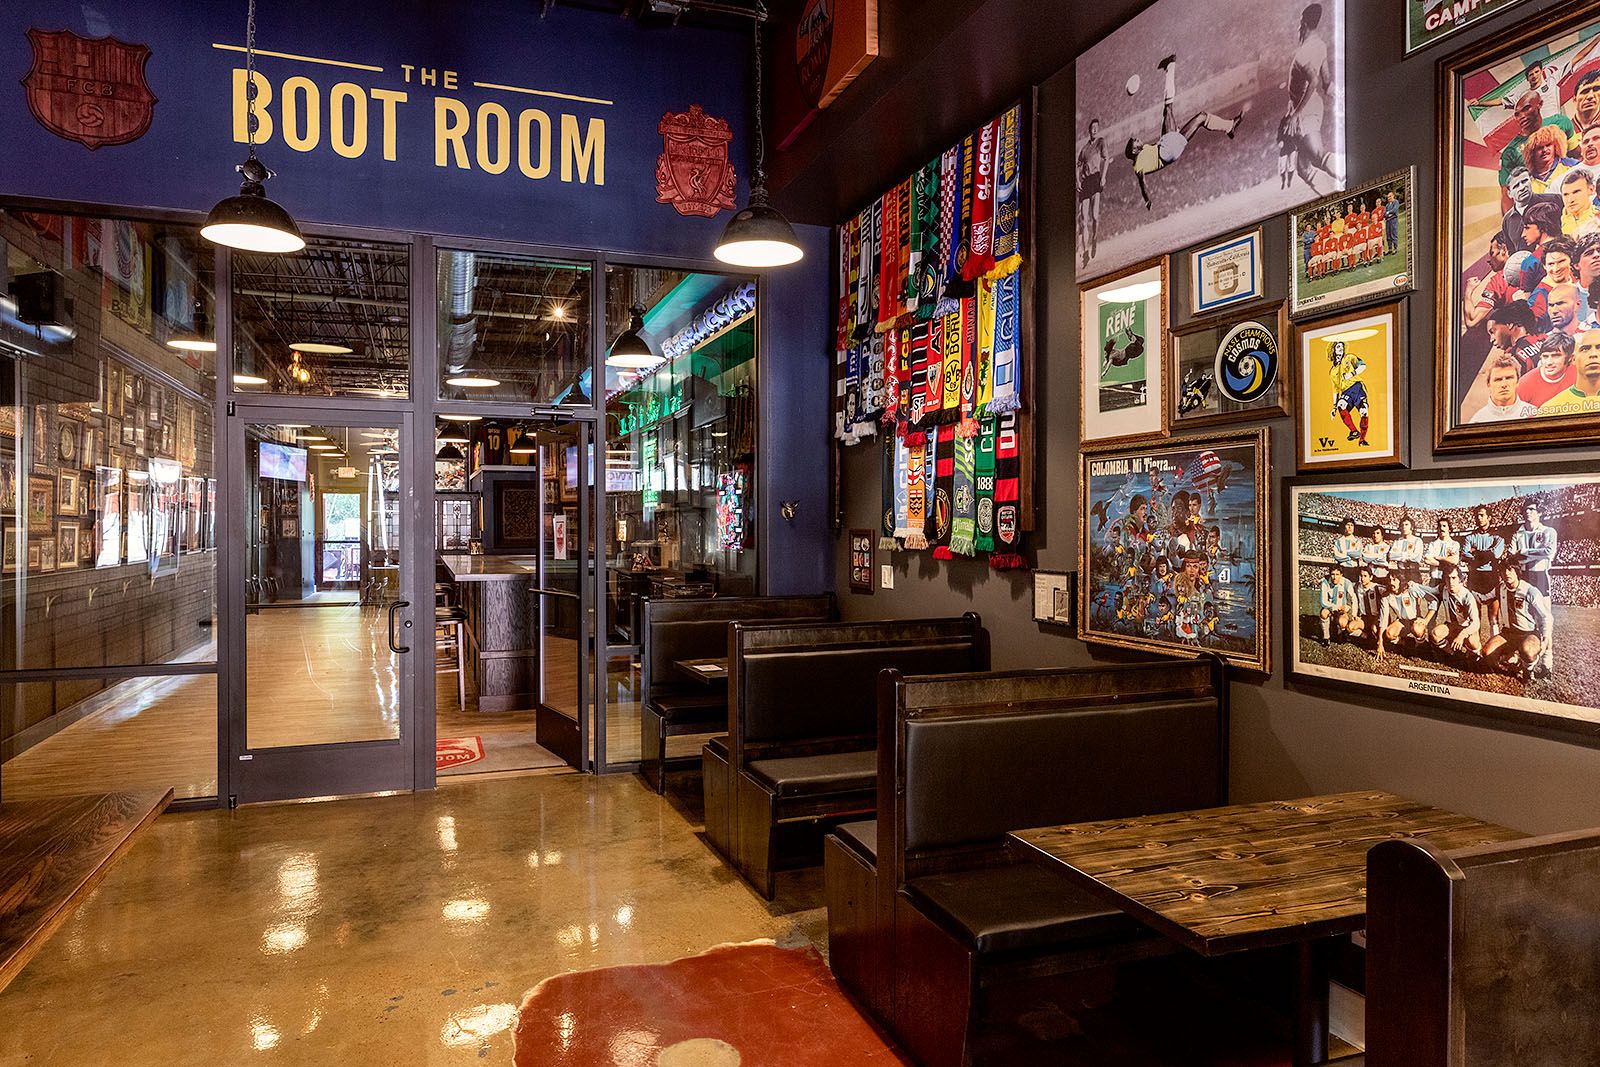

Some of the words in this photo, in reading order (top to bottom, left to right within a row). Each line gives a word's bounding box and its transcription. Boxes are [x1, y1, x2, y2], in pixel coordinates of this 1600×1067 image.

[1425, 0, 1491, 31] CAMP
[401, 64, 459, 90] THE
[232, 68, 408, 161] BOOT
[434, 97, 607, 186] ROOM
[1106, 302, 1137, 338] RENÉ
[1224, 337, 1240, 357] NASL
[1239, 329, 1276, 355] CHAMPIONS
[1228, 338, 1261, 363] COSMOS
[1520, 403, 1580, 417] Alessandro
[488, 435, 501, 451] 10
[1319, 437, 1335, 448] Vv
[1132, 458, 1143, 473] Mi
[1408, 681, 1451, 696] ARGENTINA
